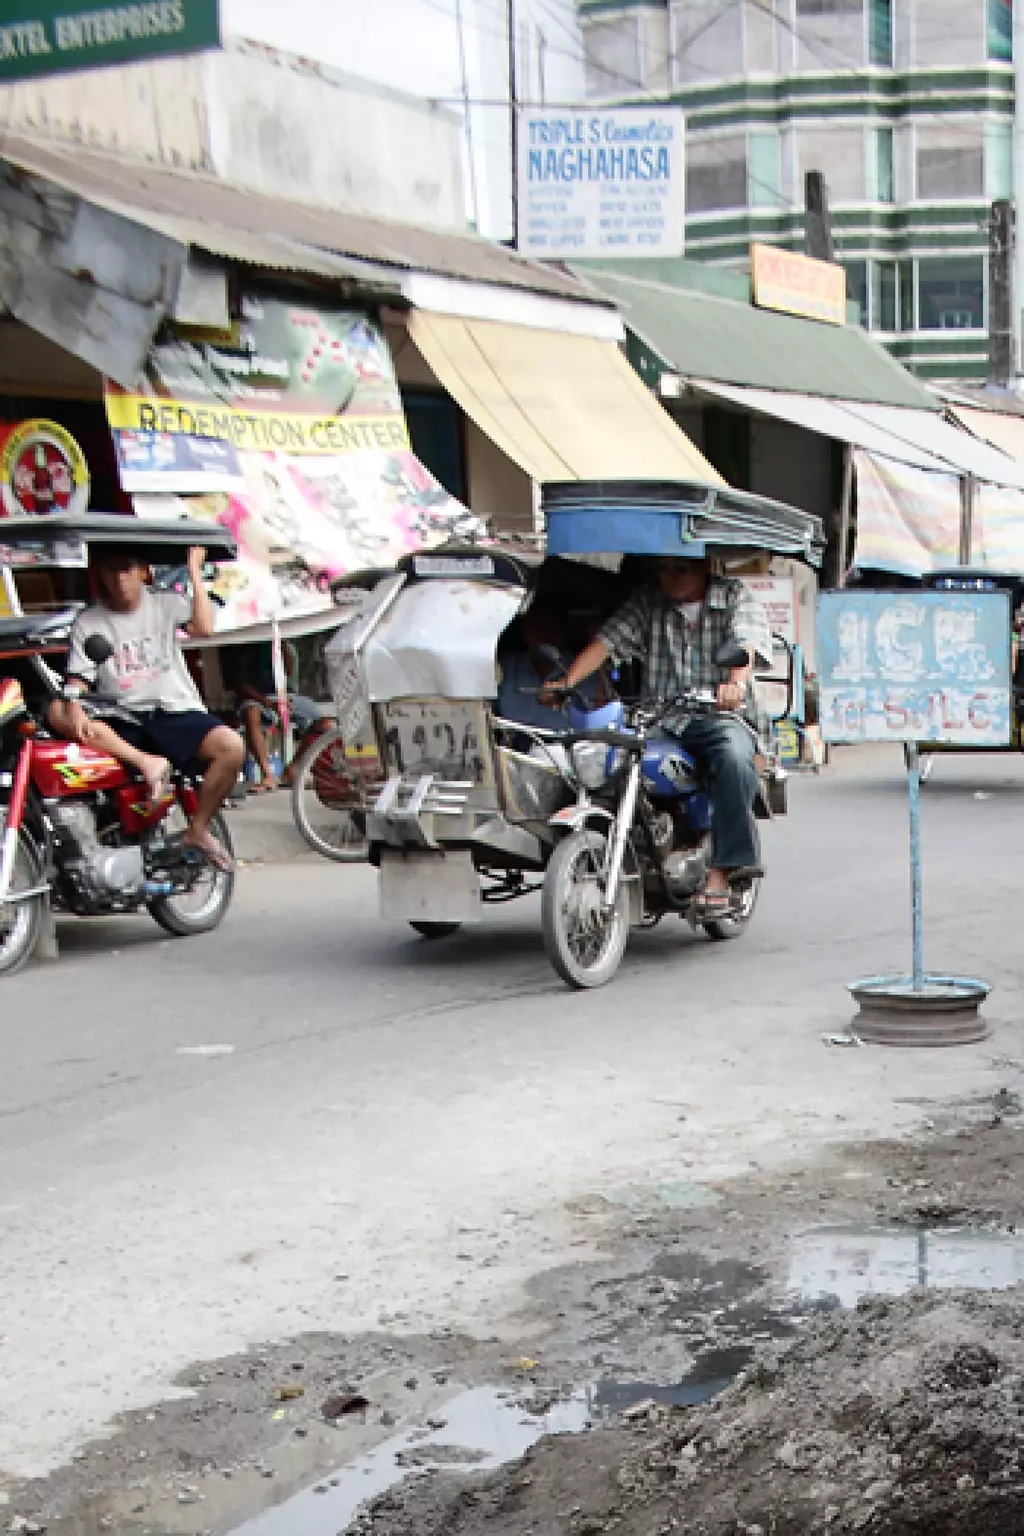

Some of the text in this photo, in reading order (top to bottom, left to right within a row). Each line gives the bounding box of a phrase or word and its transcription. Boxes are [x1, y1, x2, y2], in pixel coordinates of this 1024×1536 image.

[54, 0, 185, 50] ENTERPRISES
[528, 118, 584, 144] TRIPLE
[527, 146, 671, 182] NAGHAHASA
[138, 402, 304, 450] REDEMPTION
[308, 420, 406, 449] CENTER
